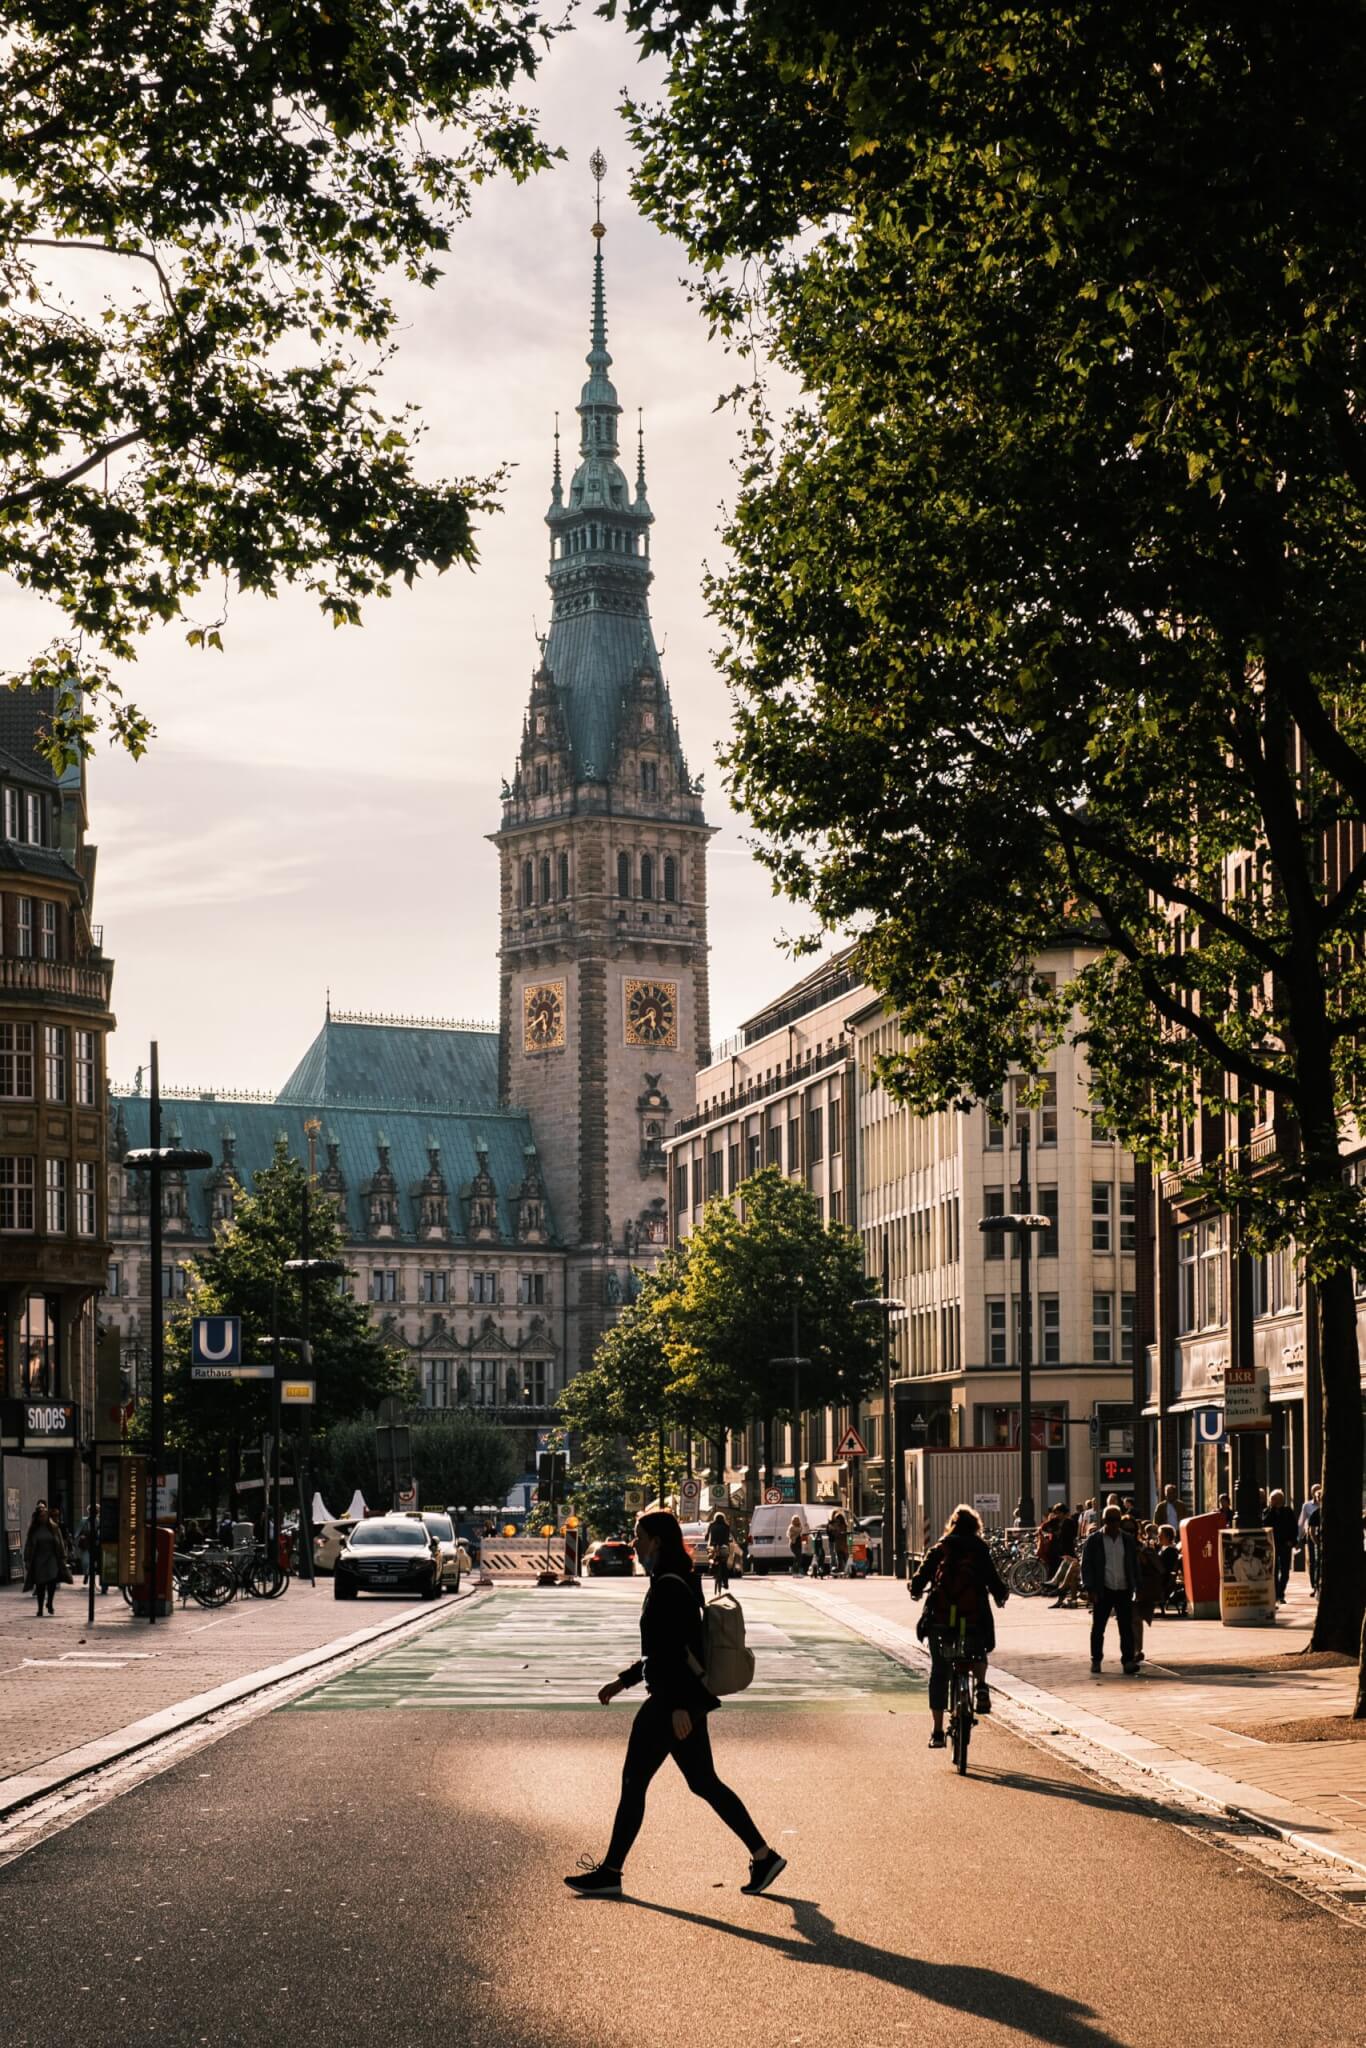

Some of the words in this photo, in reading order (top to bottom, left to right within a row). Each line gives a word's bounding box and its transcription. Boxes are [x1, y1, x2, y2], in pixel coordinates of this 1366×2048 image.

[199, 1320, 233, 1361] U
[194, 1368, 233, 1378] Rathaus
[1228, 1371, 1253, 1383] LKR
[28, 1407, 66, 1434] snipes
[1200, 1412, 1224, 1441] U
[767, 1491, 779, 1501] 25
